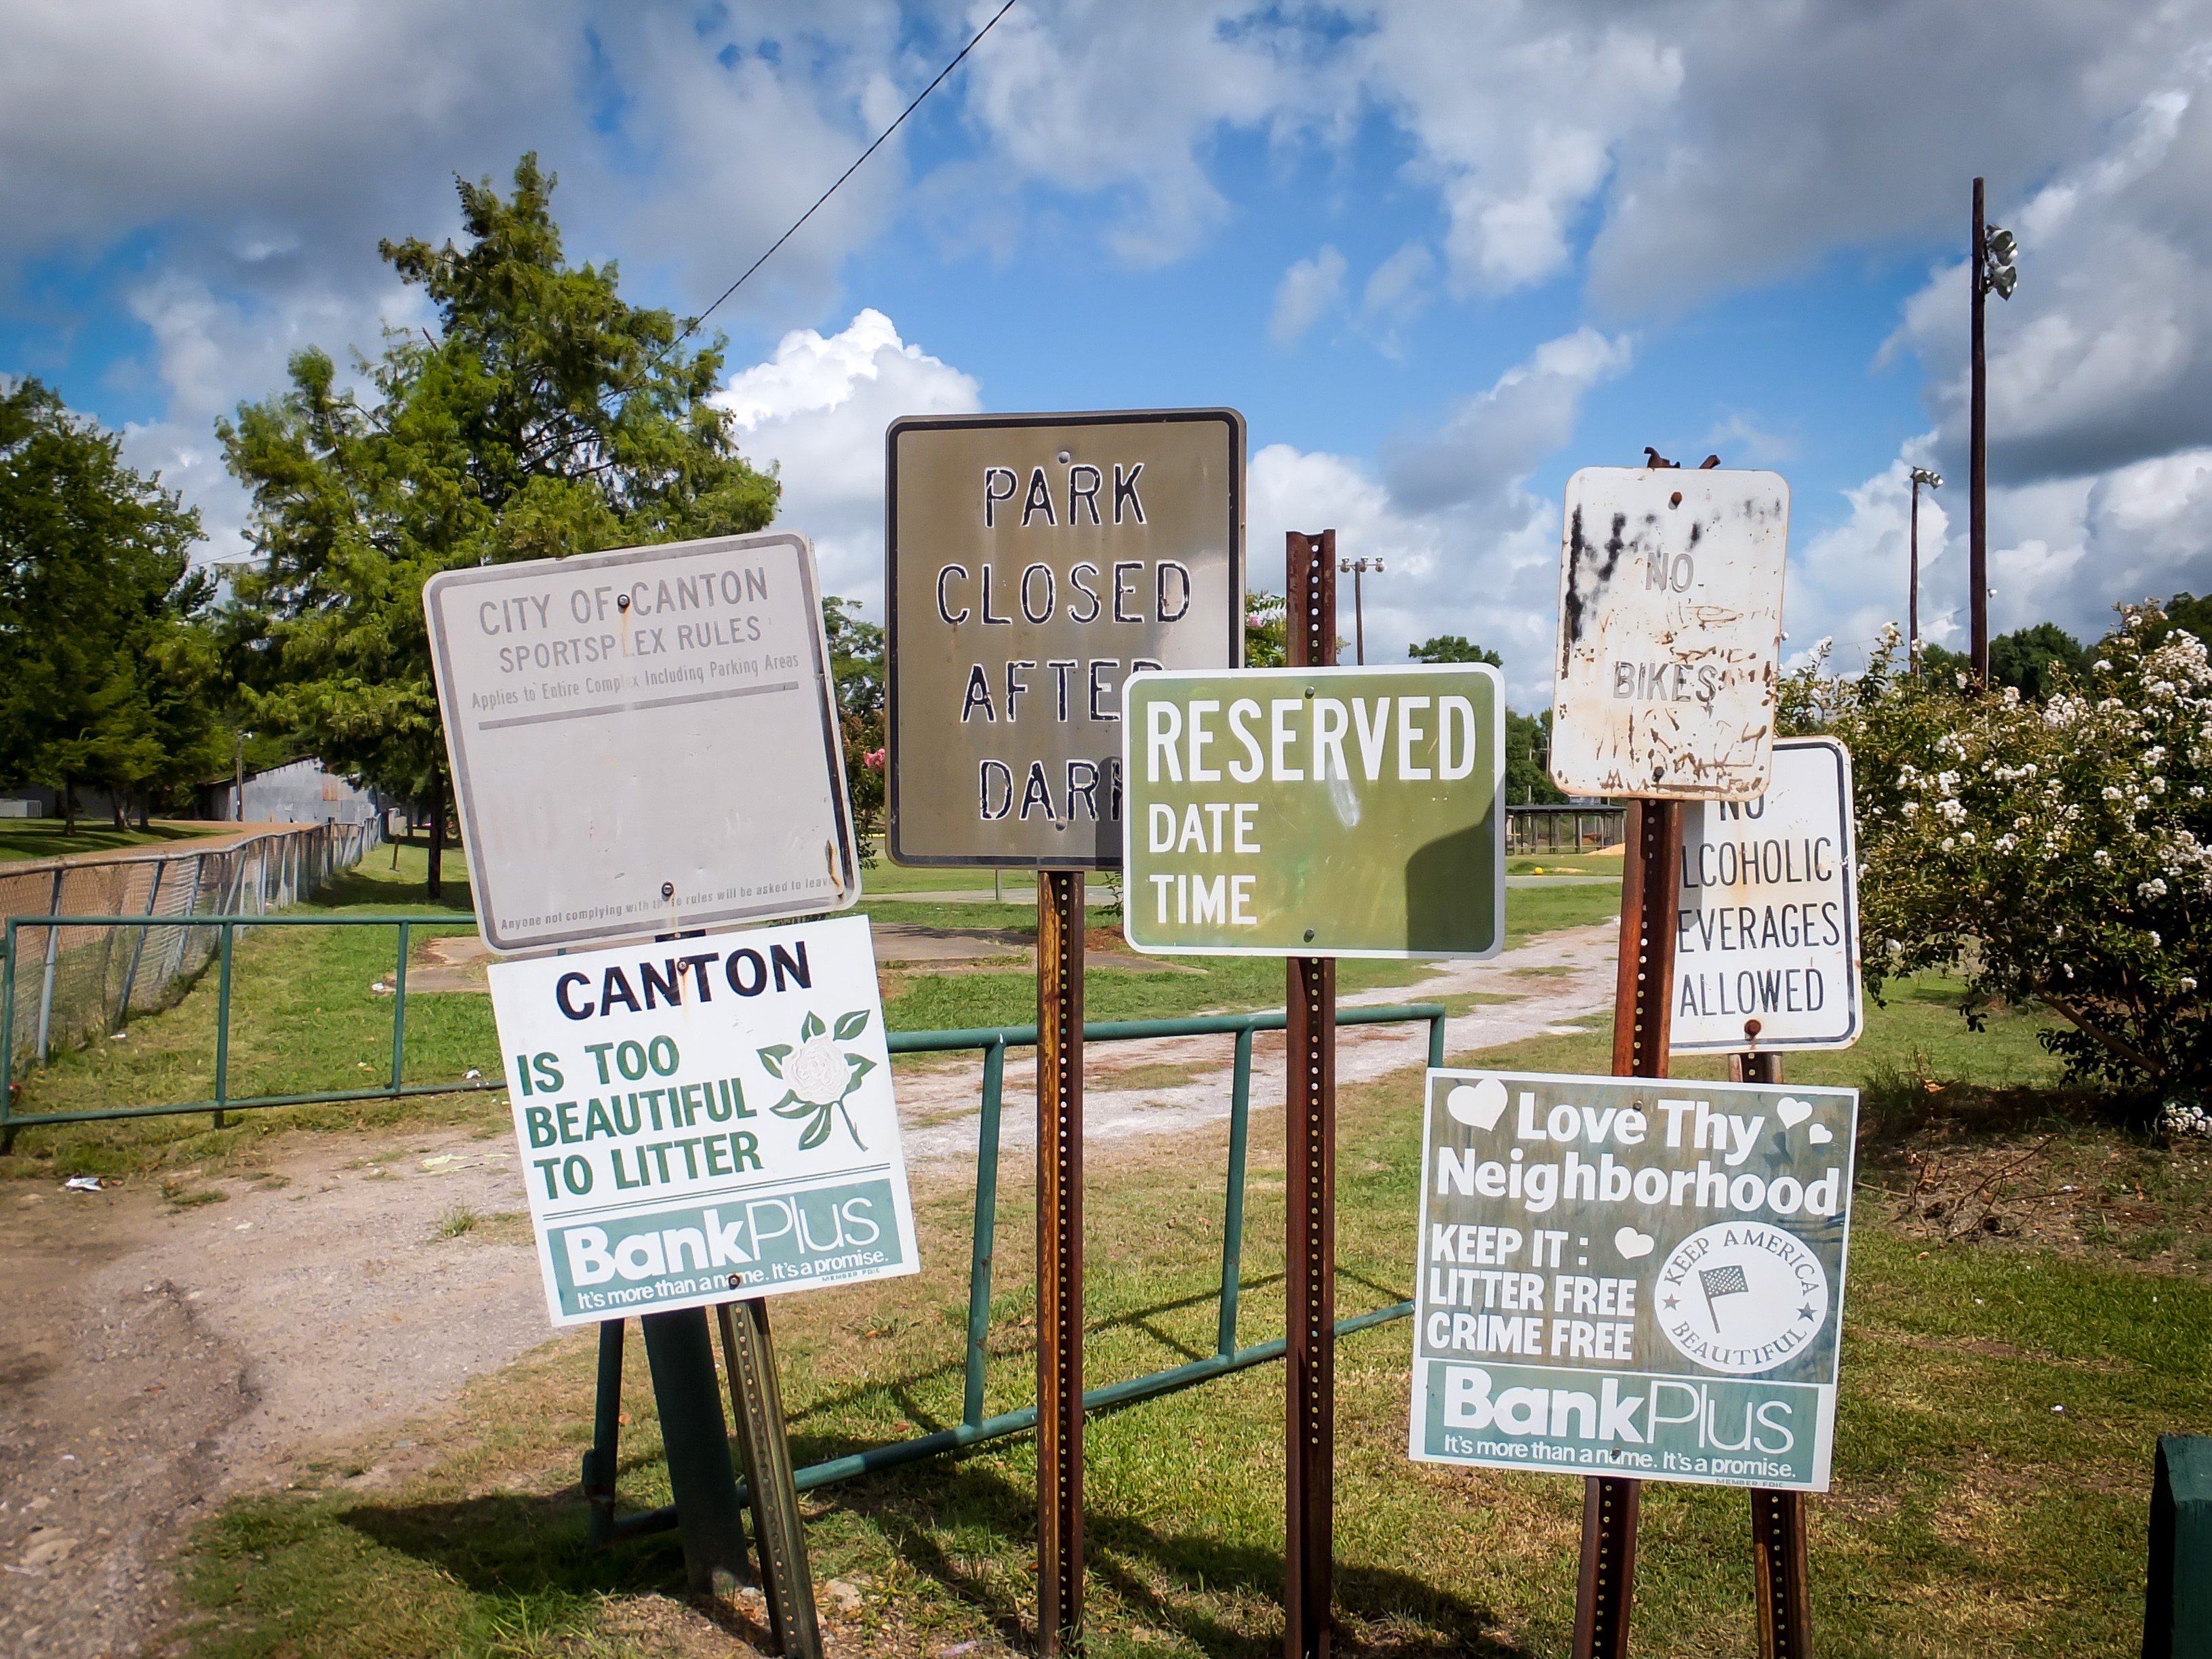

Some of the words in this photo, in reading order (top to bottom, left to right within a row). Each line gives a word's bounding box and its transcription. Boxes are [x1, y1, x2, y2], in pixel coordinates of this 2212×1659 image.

[984, 462, 1147, 527] PARK
[480, 594, 550, 635] CITY
[571, 586, 613, 624] OF
[632, 567, 769, 616] CANTON
[936, 559, 1190, 625] CLOSED
[1645, 552, 1693, 593] NO
[500, 627, 667, 673] SPORTSPLEX
[678, 616, 761, 650] RULES
[472, 689, 518, 711] Applies
[524, 686, 536, 702] to
[542, 681, 580, 699] Entire
[586, 675, 639, 693] Complx
[645, 664, 704, 685] Including
[710, 658, 758, 677] Parking
[765, 654, 799, 671] Areas
[960, 658, 1166, 723] AFTE
[1613, 661, 1718, 703] BIKES
[1147, 696, 1476, 783] RESERVED
[1149, 803, 1260, 854] DATE
[1682, 837, 1831, 888] LCOHOLIC
[502, 916, 541, 930] Anyone
[546, 913, 562, 924] not
[566, 905, 622, 919] complying
[626, 900, 649, 913] with
[686, 893, 712, 904] rules
[717, 888, 736, 900] will
[740, 887, 752, 898] be
[757, 881, 787, 895] asked
[791, 879, 801, 890] to
[1149, 875, 1258, 925] TIME
[1678, 901, 1840, 953] EVERAGES
[556, 941, 812, 1020] CANTON
[1680, 967, 1824, 1017] ALLOWED
[517, 1052, 564, 1096] IS
[585, 1035, 679, 1085] TOO
[525, 1078, 757, 1149] BEAUTIFUL
[1518, 1092, 1647, 1144] Love
[1657, 1099, 1765, 1166] Thy
[533, 1155, 594, 1199] TO
[611, 1131, 763, 1190] LITTER
[1436, 1146, 1840, 1216] Neighborhood
[563, 1197, 880, 1287] BankPlus
[1431, 1223, 1523, 1265] KEEP
[1664, 1237, 1709, 1286] KEEP
[1723, 1228, 1819, 1296] AMERICA
[578, 1292, 605, 1309] It's
[608, 1285, 654, 1304] more
[655, 1279, 696, 1297] than
[699, 1277, 712, 1291] a
[772, 1262, 799, 1280] It's
[800, 1262, 813, 1276] a
[814, 1250, 889, 1275] promise.
[1430, 1267, 1544, 1311] LITTER
[1554, 1275, 1636, 1317] FREE
[1427, 1312, 1543, 1355] CRIME
[1551, 1319, 1634, 1360] FREE
[1672, 1321, 1808, 1365] BEAUTIFUL
[1443, 1366, 1794, 1454] BankPlus
[1444, 1434, 1473, 1454] It's
[1477, 1440, 1528, 1458] more
[1531, 1441, 1575, 1462] than
[1580, 1448, 1592, 1463] a
[1663, 1451, 1693, 1471] It's
[1695, 1458, 1708, 1472] a
[1711, 1458, 1796, 1478] promise.
